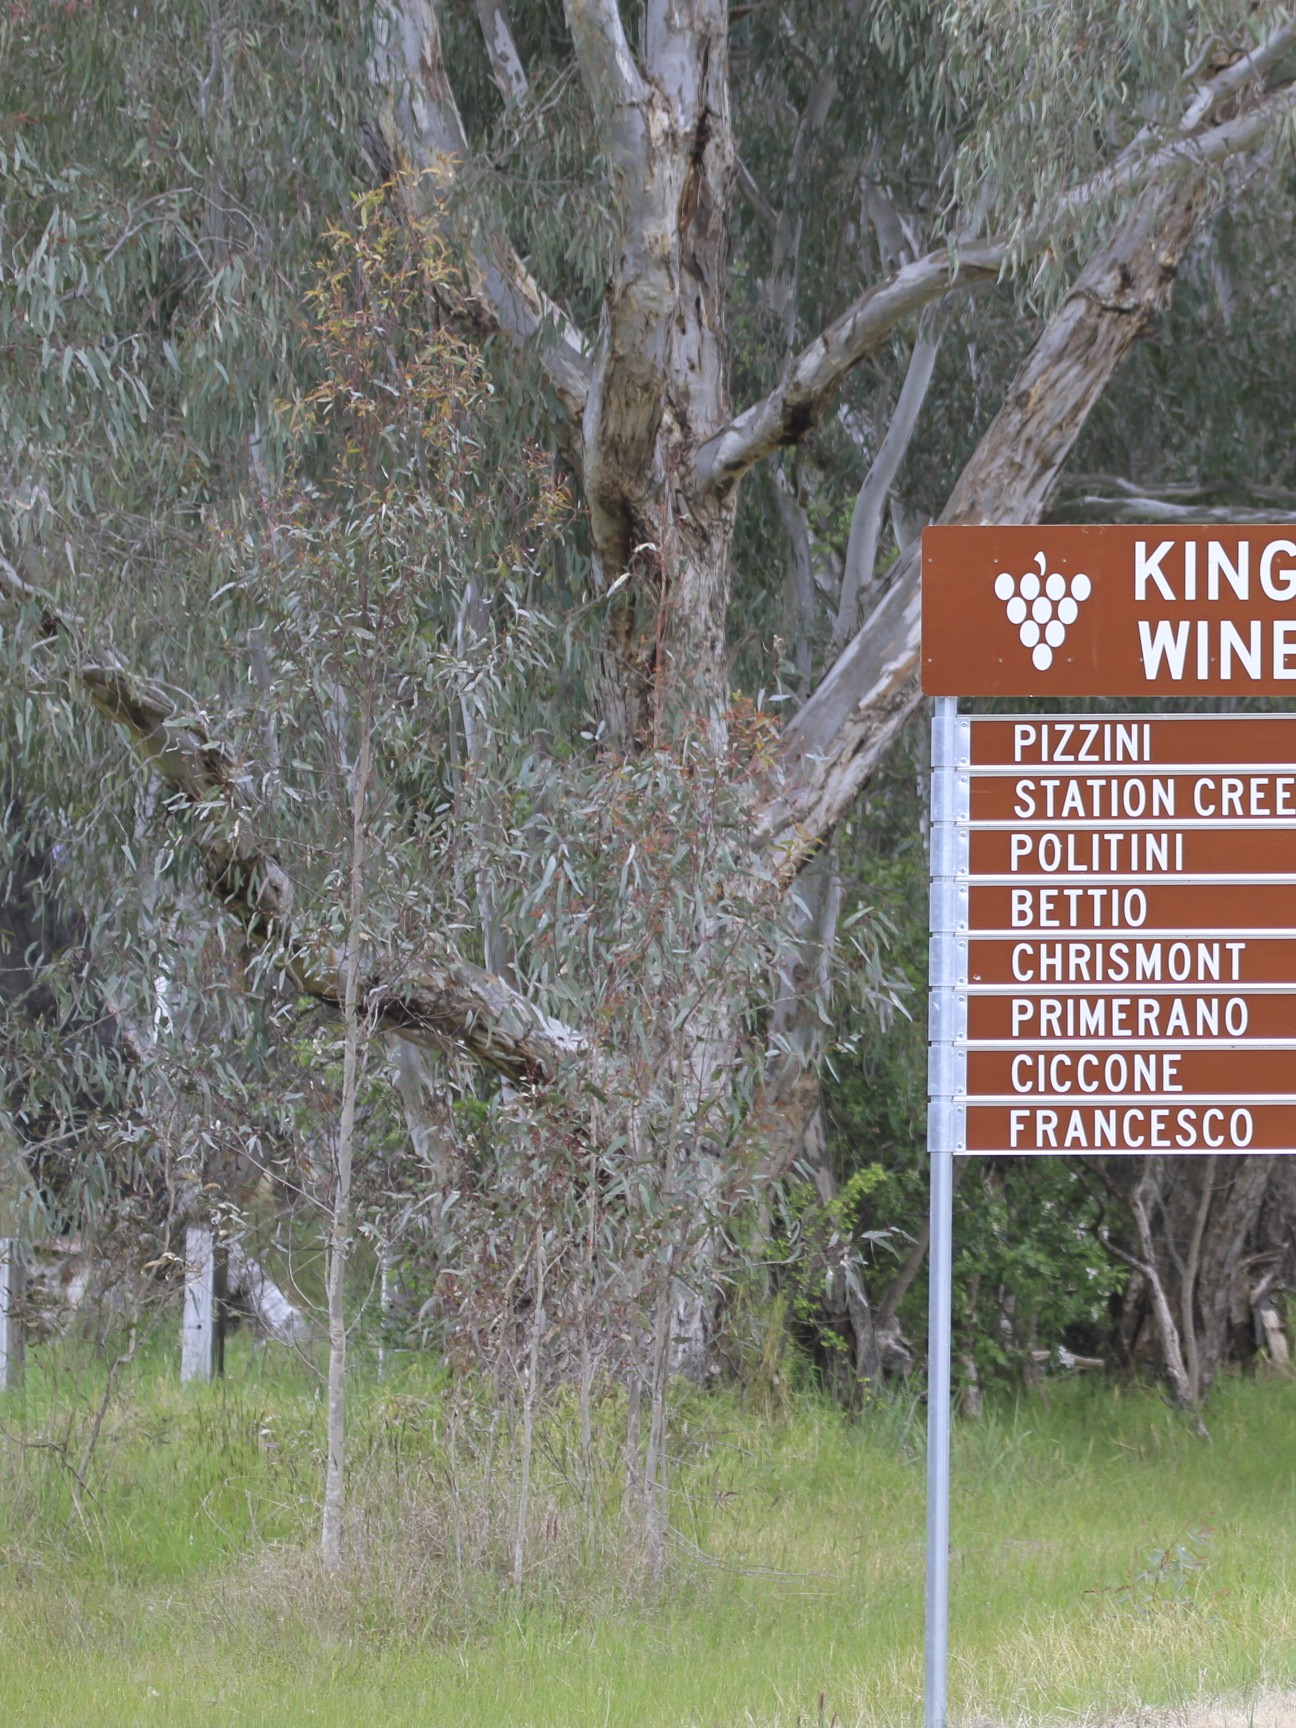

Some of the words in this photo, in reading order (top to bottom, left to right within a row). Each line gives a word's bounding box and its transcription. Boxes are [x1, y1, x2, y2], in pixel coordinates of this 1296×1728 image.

[1014, 724, 1151, 762] PIZZINI
[1014, 778, 1175, 818] STATION
[1011, 833, 1183, 872] POLITINI
[1011, 888, 1147, 927] BETTIO
[1011, 942, 1246, 982] CHRISMONT
[1011, 997, 1249, 1037] PRIMERANO
[1011, 1053, 1183, 1093] CICCONE
[1010, 1107, 1254, 1148] FRANCESCO
